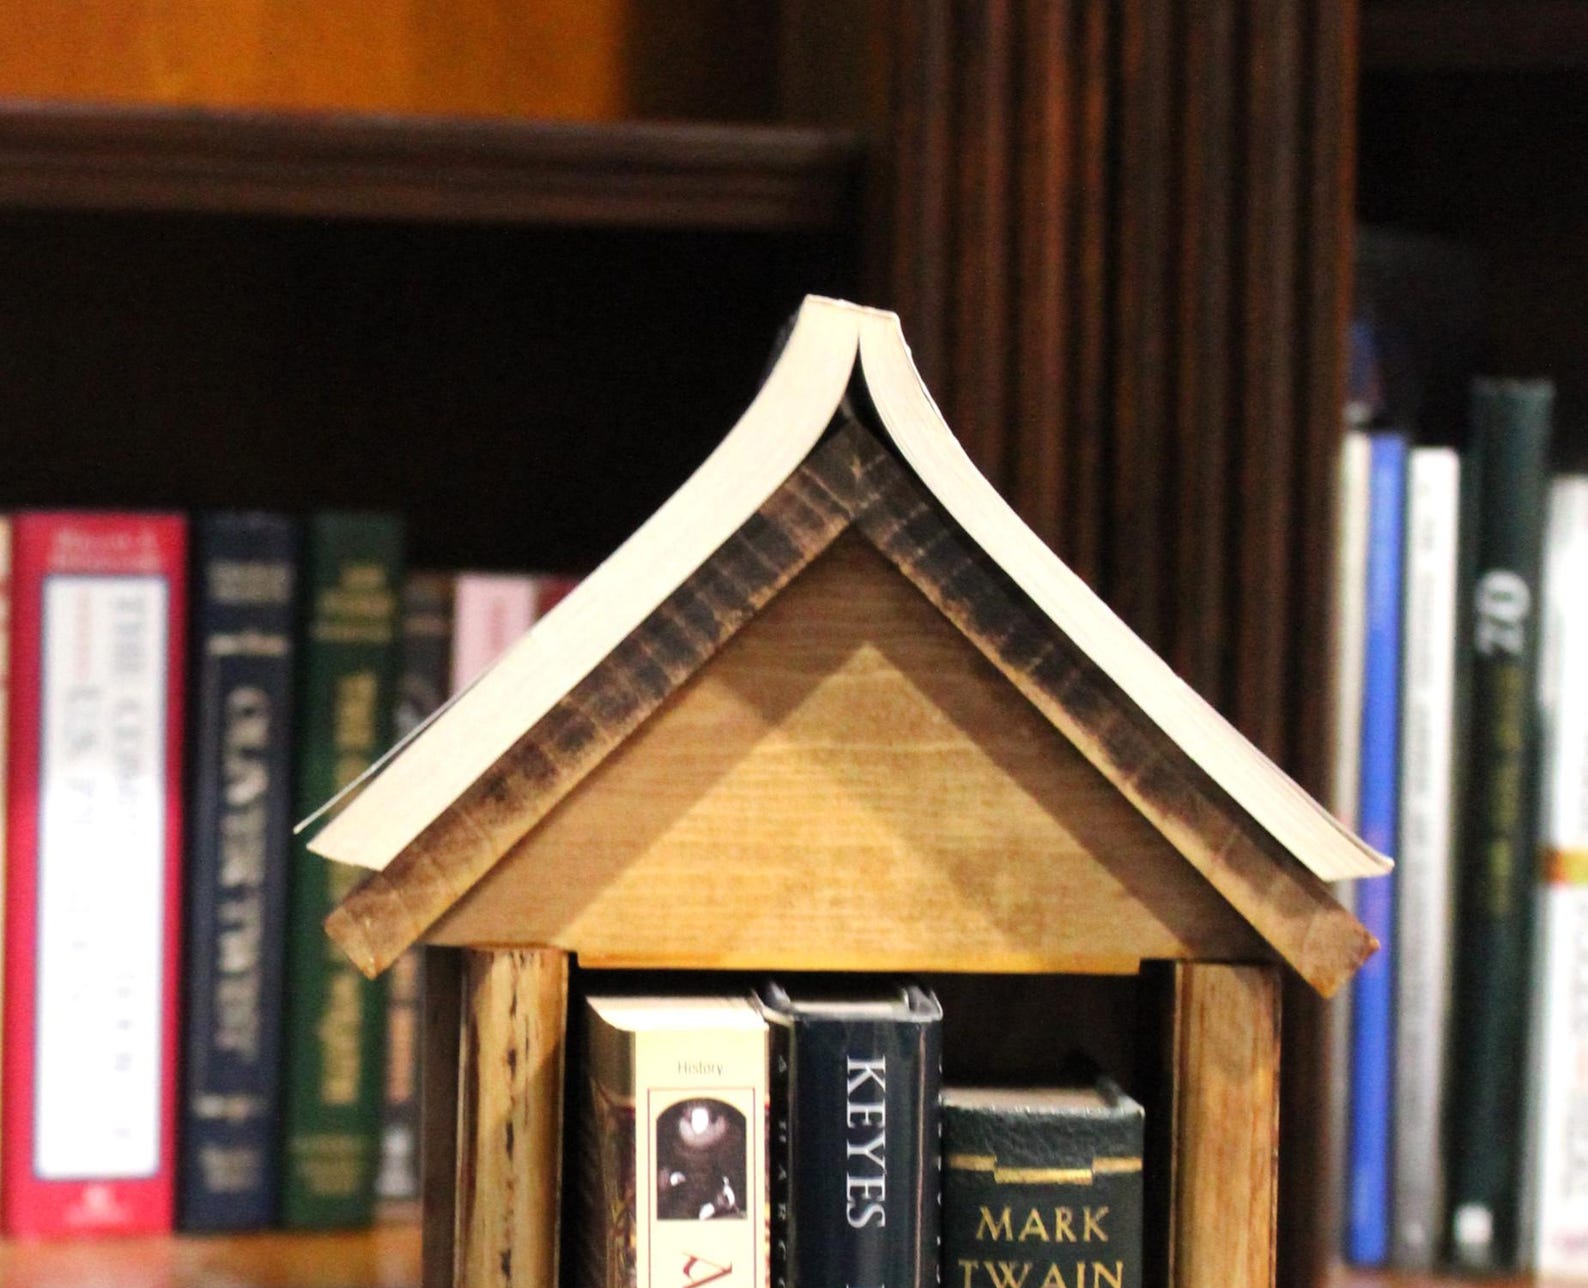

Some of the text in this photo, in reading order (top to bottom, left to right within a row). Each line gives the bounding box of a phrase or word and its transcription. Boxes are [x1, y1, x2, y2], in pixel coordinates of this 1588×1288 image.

[677, 1060, 724, 1077] History
[845, 1054, 886, 1229] KEYES
[975, 1205, 1110, 1243] MARK
